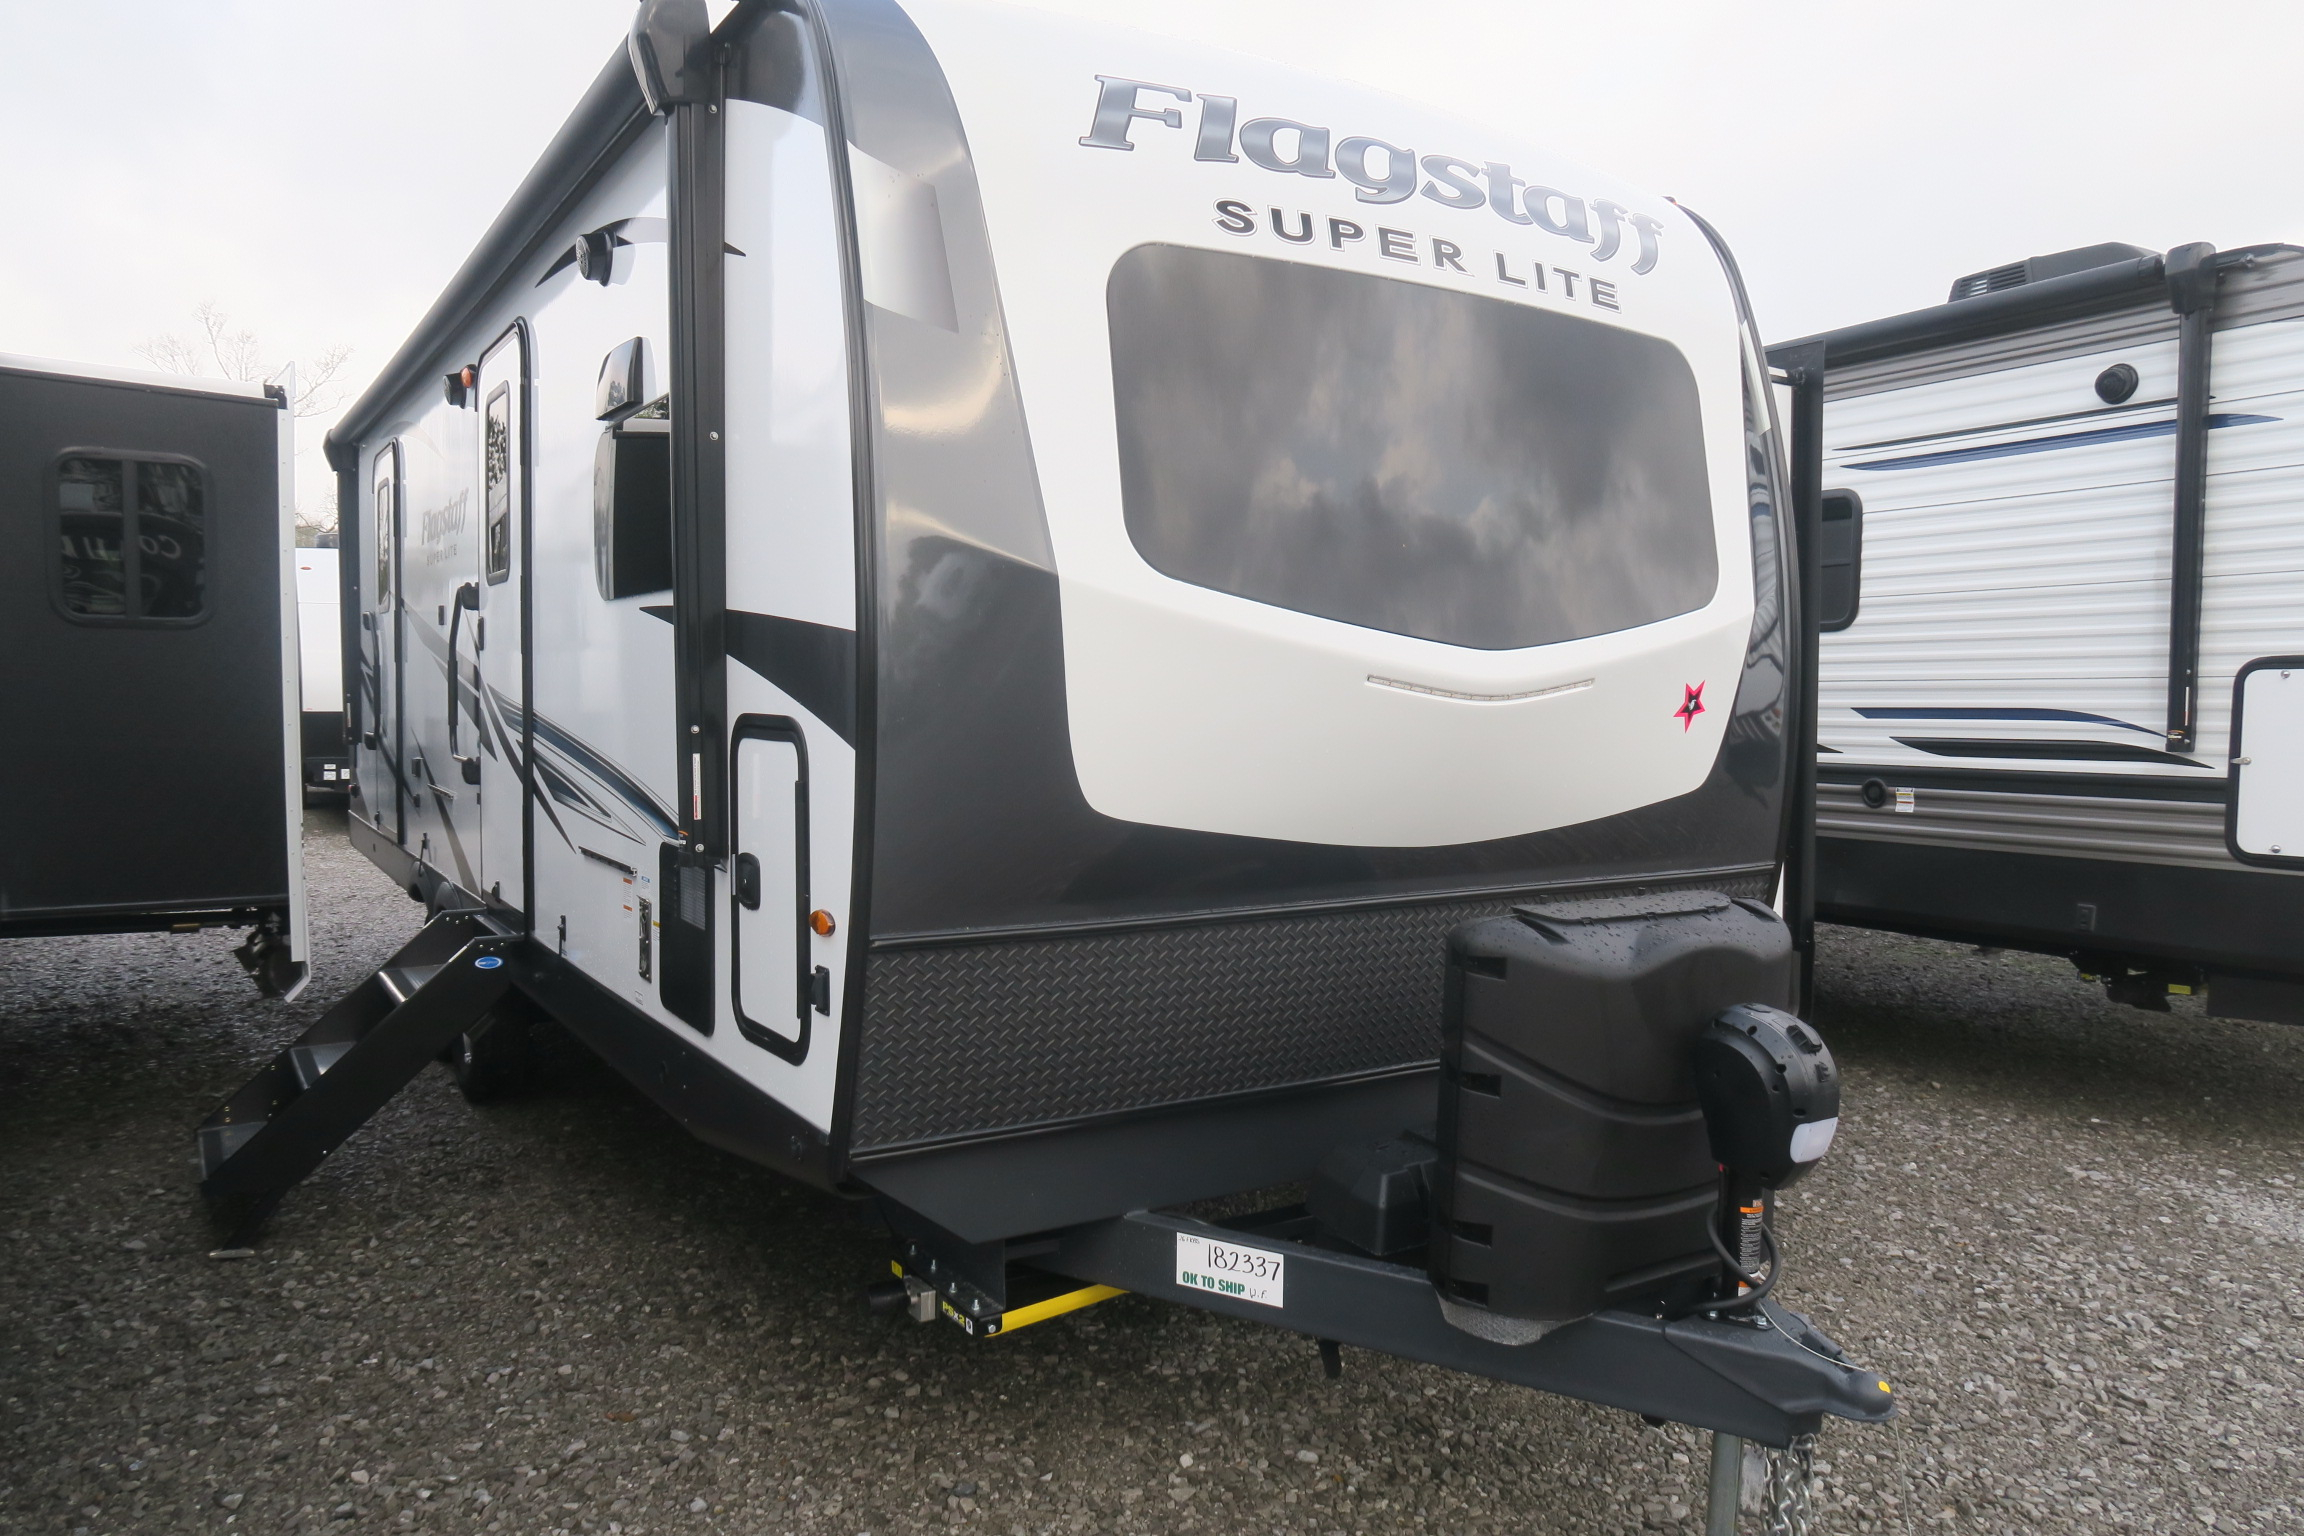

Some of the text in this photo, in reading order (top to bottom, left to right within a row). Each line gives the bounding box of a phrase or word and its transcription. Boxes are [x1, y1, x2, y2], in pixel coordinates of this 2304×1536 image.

[1079, 73, 1665, 275] Flagstaff
[1214, 197, 1623, 313] SUPER LITE
[1182, 1271, 1246, 1295] OK TO SHIP
[1208, 1243, 1280, 1281] 182337
